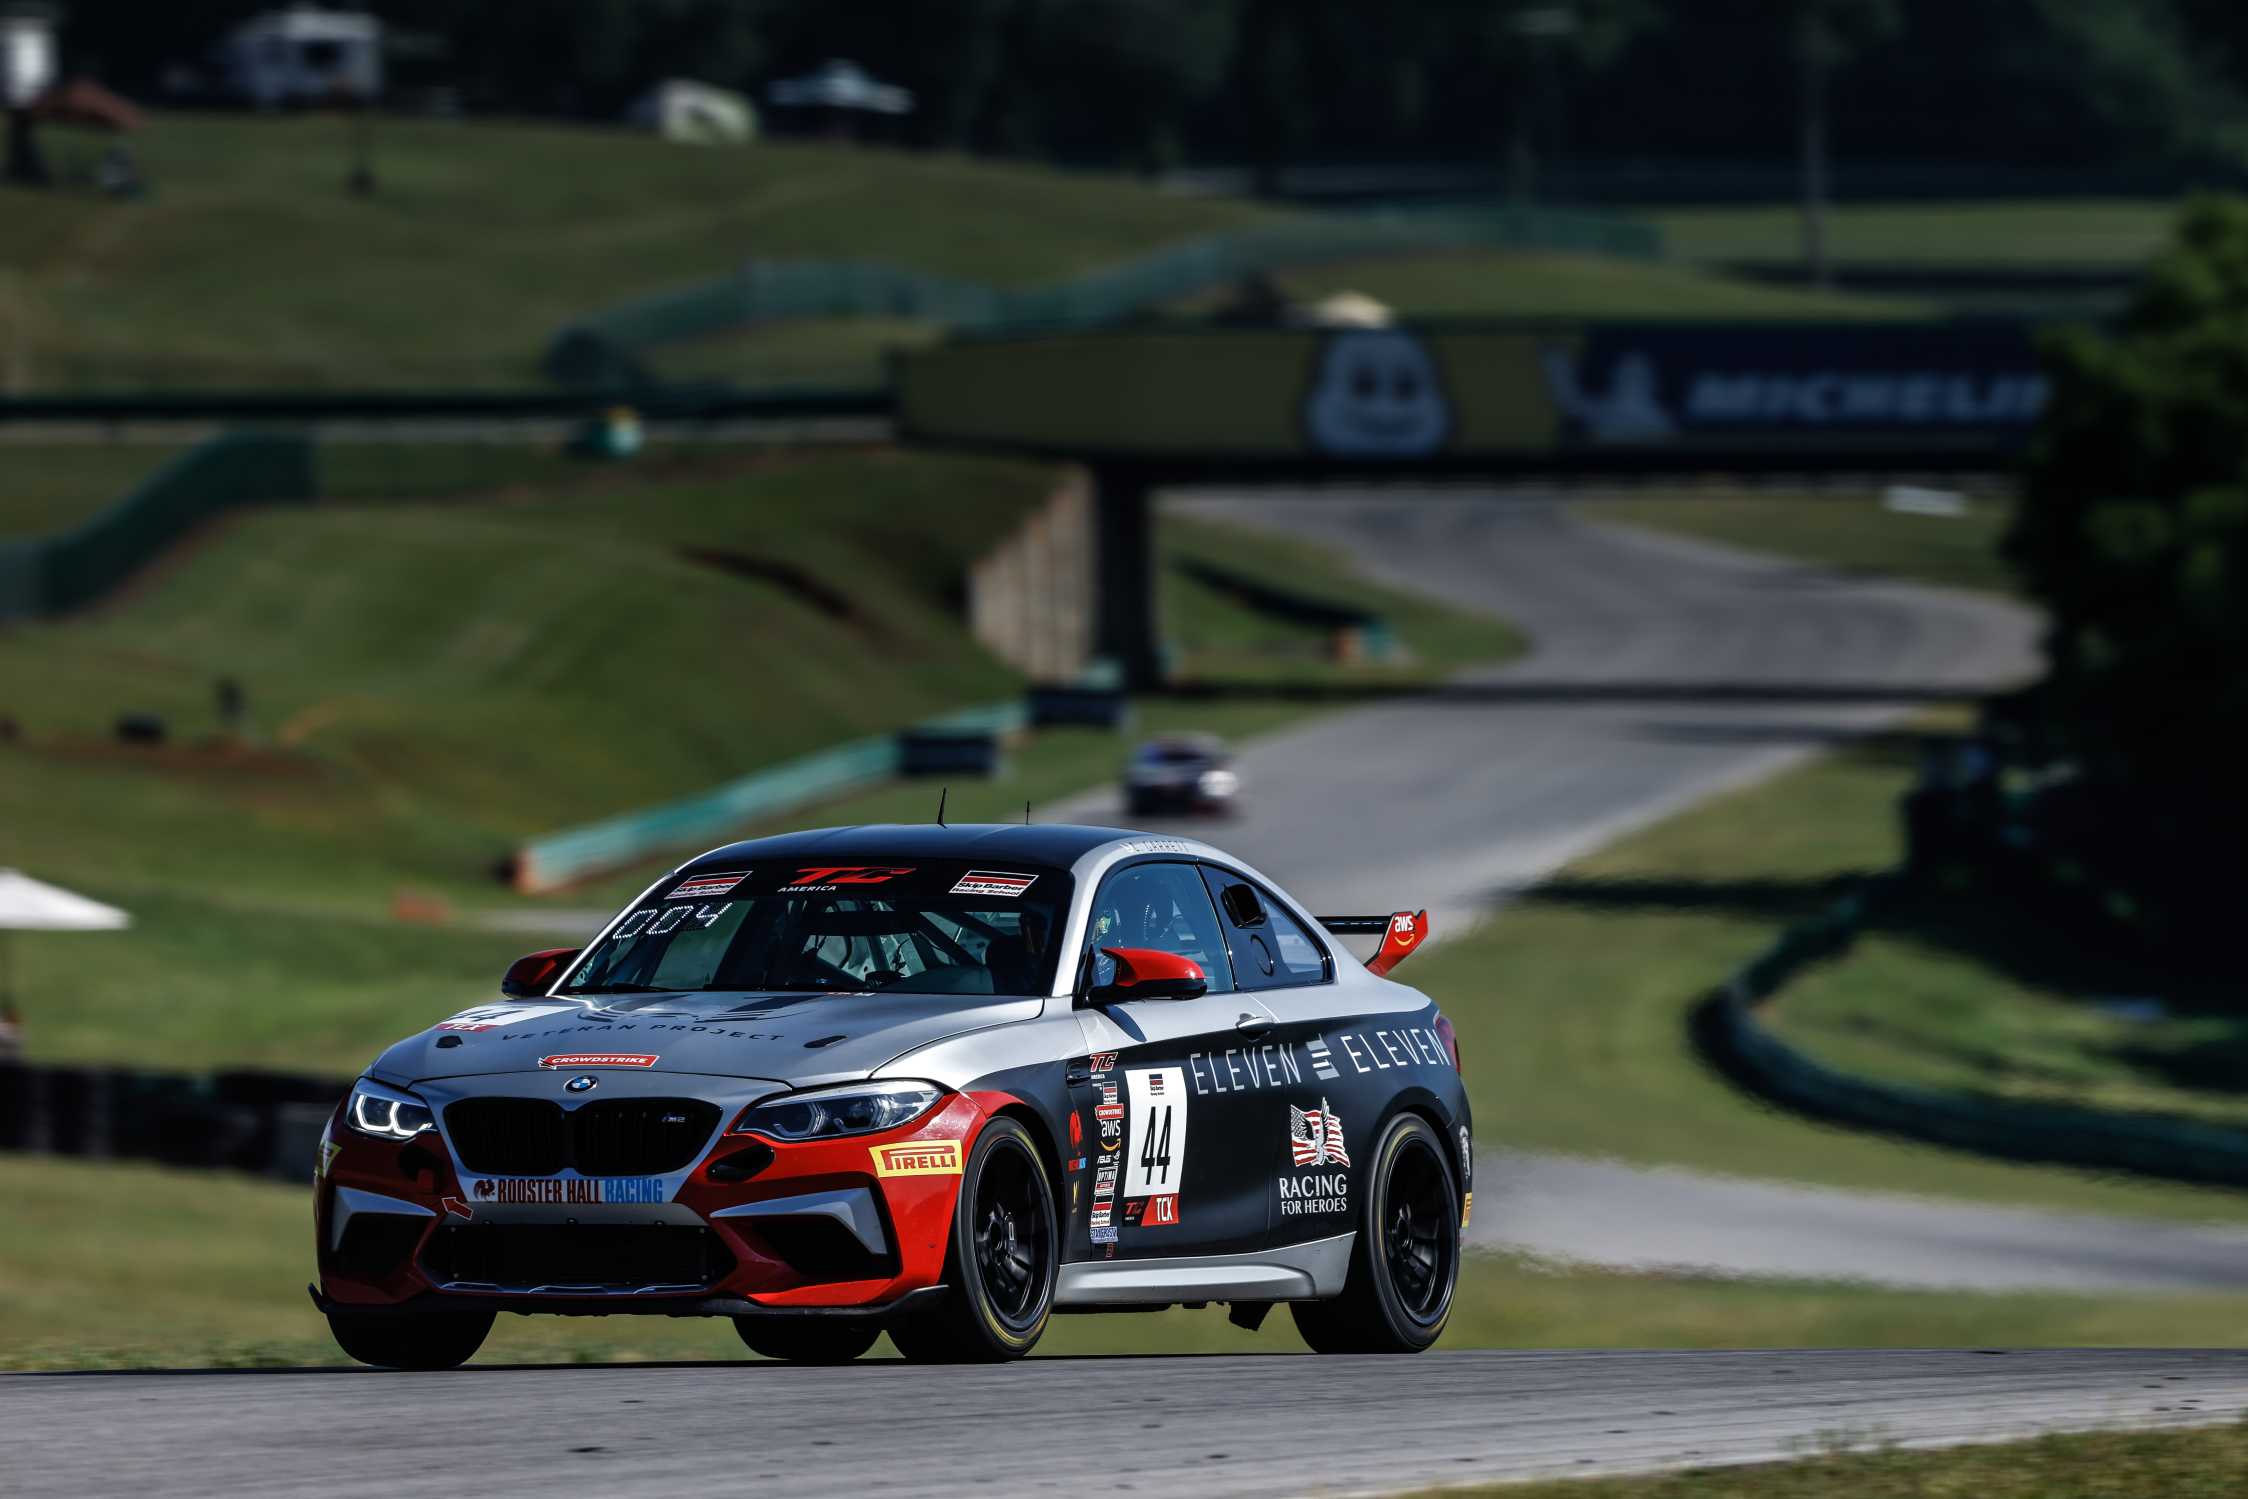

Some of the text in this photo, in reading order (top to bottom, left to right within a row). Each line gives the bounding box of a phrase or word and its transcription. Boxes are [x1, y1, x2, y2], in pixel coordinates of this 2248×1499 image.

[984, 883, 1026, 891] Barber
[1395, 915, 1414, 932] aws
[502, 1024, 785, 1041] VETERAN PROJECT
[1090, 1052, 1118, 1072] TC
[1340, 1028, 1451, 1073] ELEVEN
[1190, 1043, 1302, 1095] ELEVEN
[1101, 1120, 1120, 1137] aws
[880, 1145, 957, 1170] PIRELLI
[1141, 1105, 1171, 1185] 44
[499, 1178, 663, 1204] ROOSTER HALL RACING
[1279, 1174, 1347, 1199] RACING
[1156, 1196, 1173, 1222] TCX
[1281, 1197, 1347, 1215] FOR HEROES
